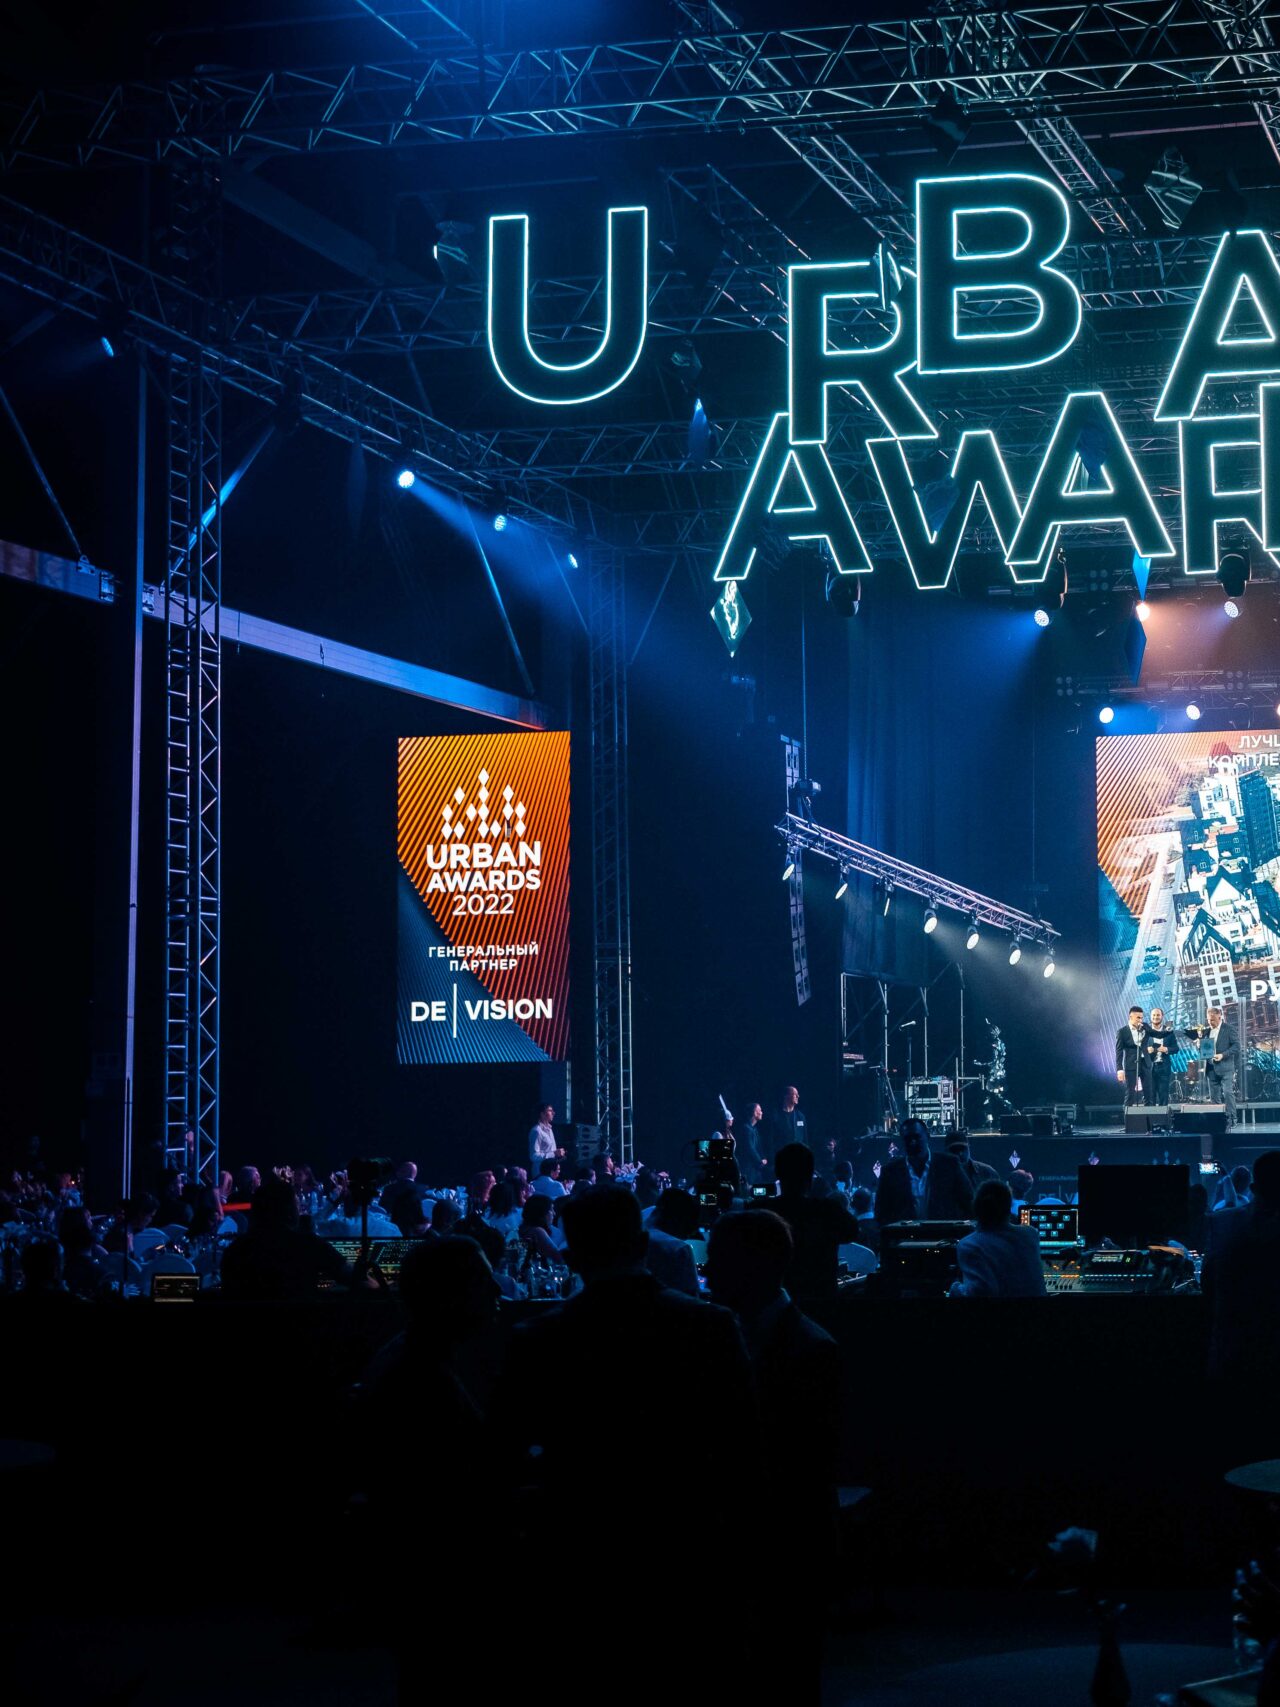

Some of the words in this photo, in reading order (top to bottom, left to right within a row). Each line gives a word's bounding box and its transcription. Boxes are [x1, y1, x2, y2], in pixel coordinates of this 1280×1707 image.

[426, 841, 542, 870] URBAN
[426, 869, 541, 894] AWARDS
[452, 893, 515, 916] 2022
[428, 941, 539, 958] ГЕНЕРАЛЬНЫЙ
[449, 958, 518, 972] ПАРТНЕР
[410, 1000, 447, 1022] DE
[464, 998, 553, 1021] VISION
